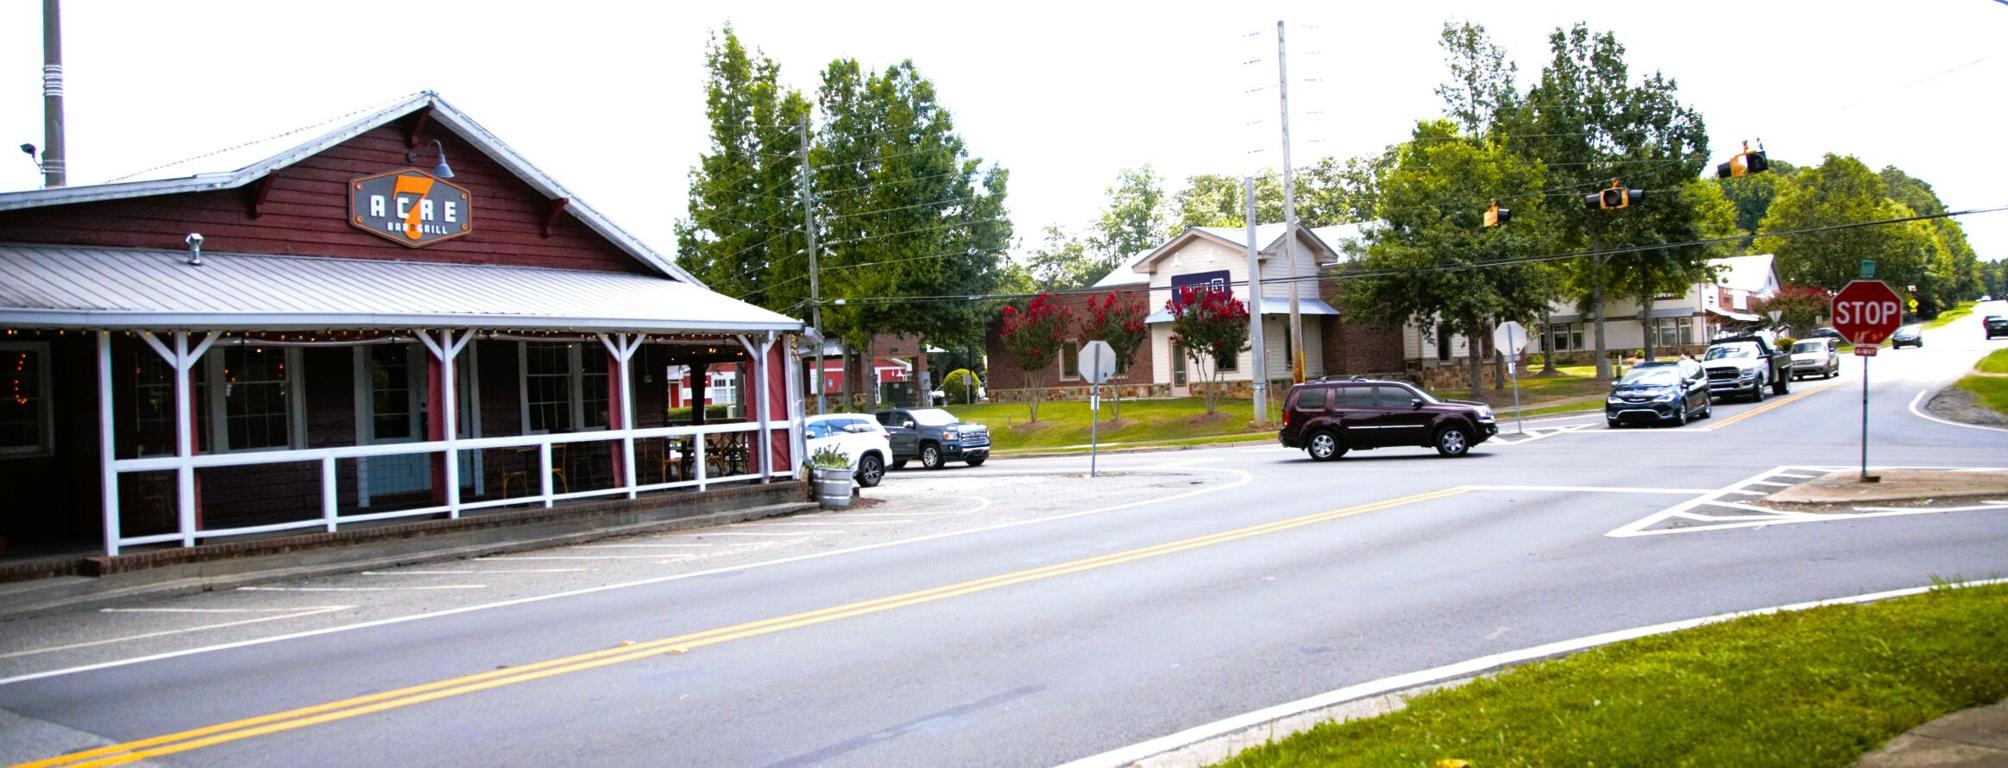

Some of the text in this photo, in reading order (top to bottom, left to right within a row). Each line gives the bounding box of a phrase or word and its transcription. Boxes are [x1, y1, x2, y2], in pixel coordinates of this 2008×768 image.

[370, 195, 456, 222] ACRE
[392, 175, 434, 240] 7
[1836, 301, 1897, 325] STOP
